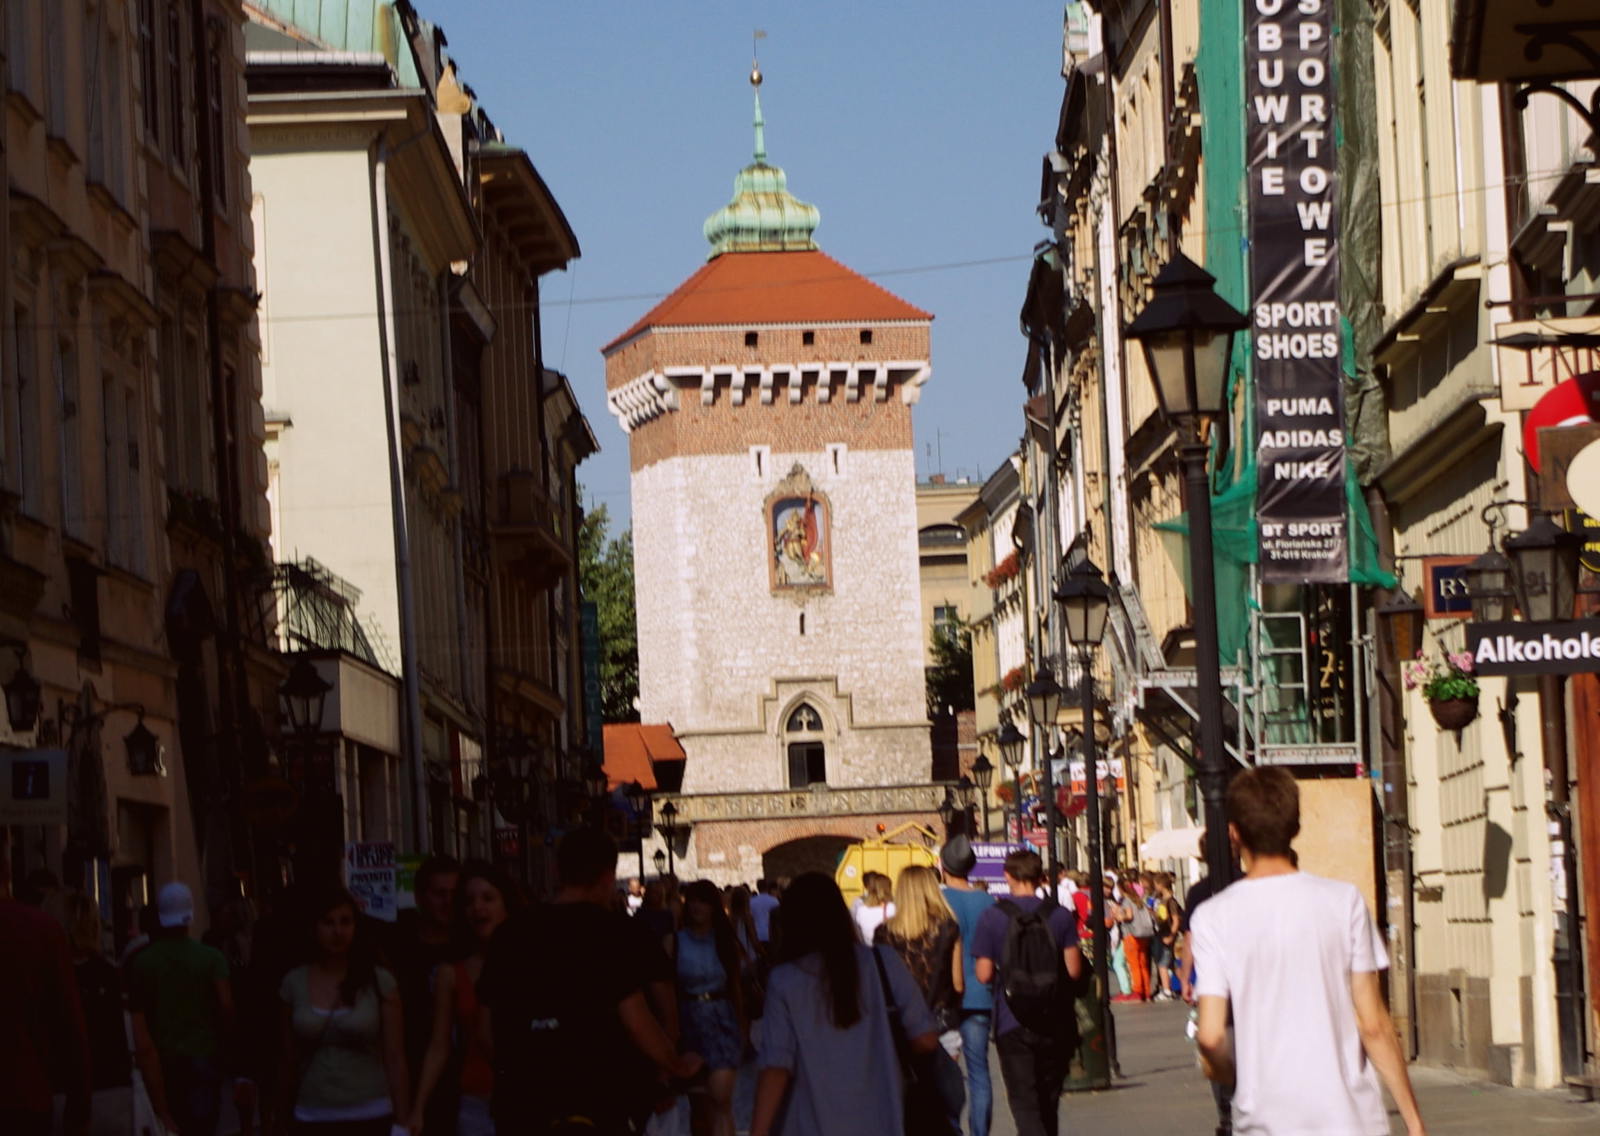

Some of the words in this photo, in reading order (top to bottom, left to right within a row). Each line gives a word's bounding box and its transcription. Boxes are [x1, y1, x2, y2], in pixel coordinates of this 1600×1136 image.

[1256, 302, 1335, 328] SPORT
[1257, 333, 1338, 360] SHOES
[1267, 397, 1333, 416] PUMA
[1259, 428, 1343, 448] ADIDAS
[1274, 461, 1329, 480] NIKE
[1262, 523, 1283, 537] BT
[1288, 522, 1342, 537] SPORT
